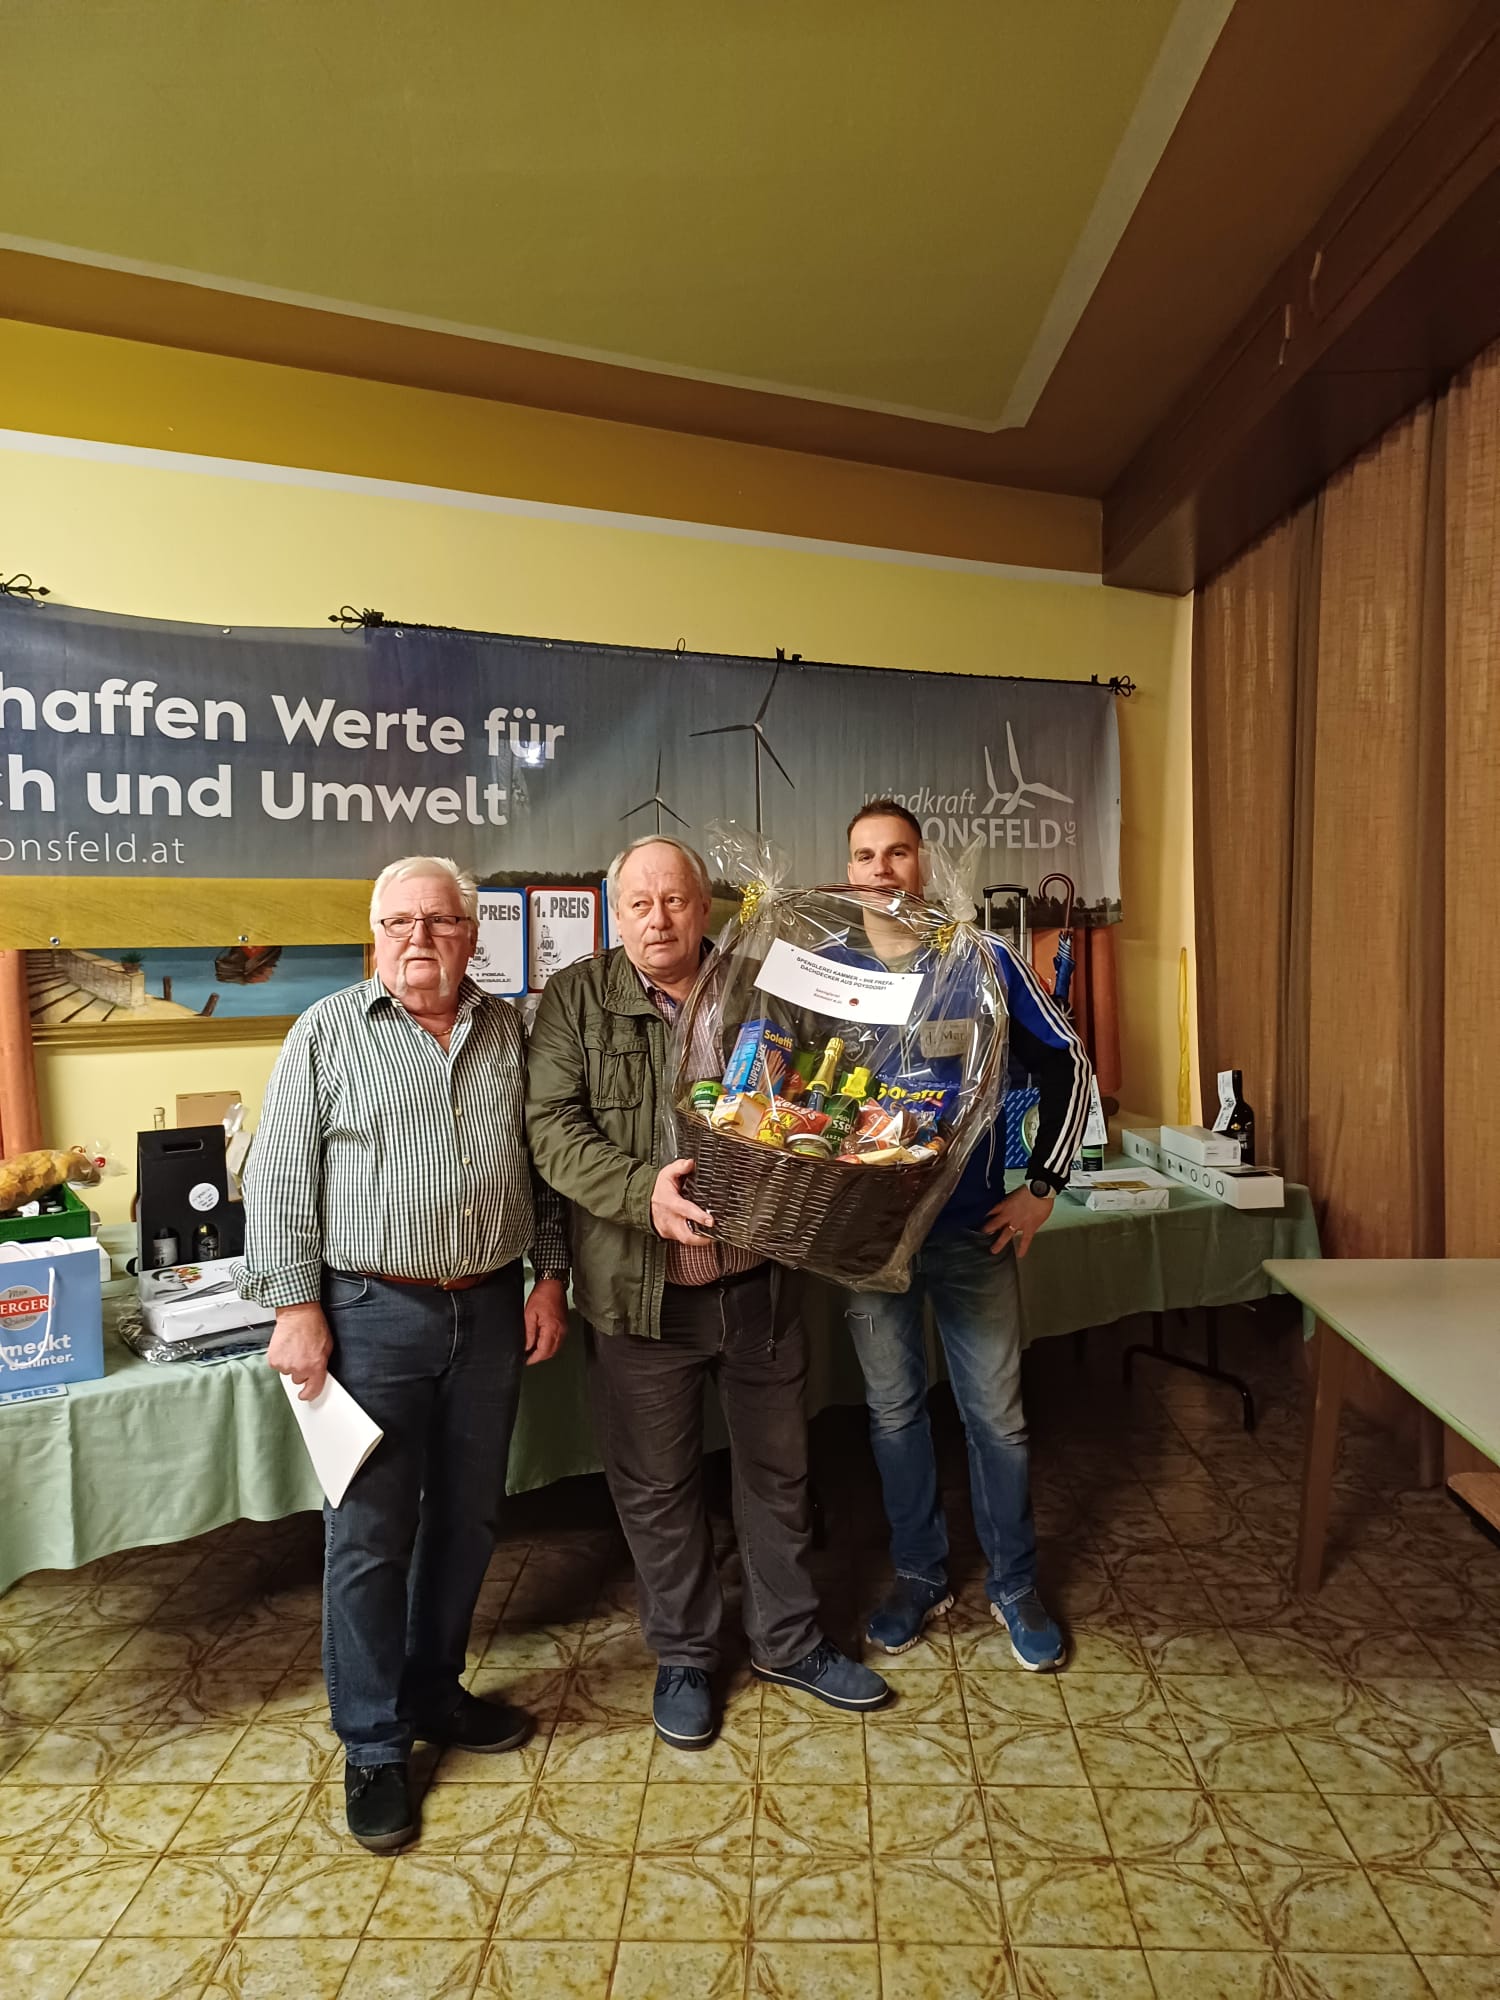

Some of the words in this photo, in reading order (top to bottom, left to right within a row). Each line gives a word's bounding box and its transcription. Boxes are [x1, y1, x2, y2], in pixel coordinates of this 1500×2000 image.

[0, 672, 247, 743] haffen
[271, 695, 465, 755] Werte
[484, 707, 565, 760] für
[0, 754, 55, 812] h
[87, 764, 232, 818] und
[261, 771, 508, 826] Umwelt
[917, 816, 1062, 849] ONSFELD
[1064, 820, 1076, 846] AG
[0, 831, 185, 864] onsfeld.at
[480, 904, 521, 921] PREIS
[534, 896, 546, 918] 1.
[550, 897, 590, 919] PREIS
[763, 1029, 793, 1049] Soletti
[747, 1060, 762, 1087] SUPER
[0, 1298, 49, 1315] ERGER
[0, 1334, 71, 1357] meckt
[11, 1386, 59, 1401] PREIS
